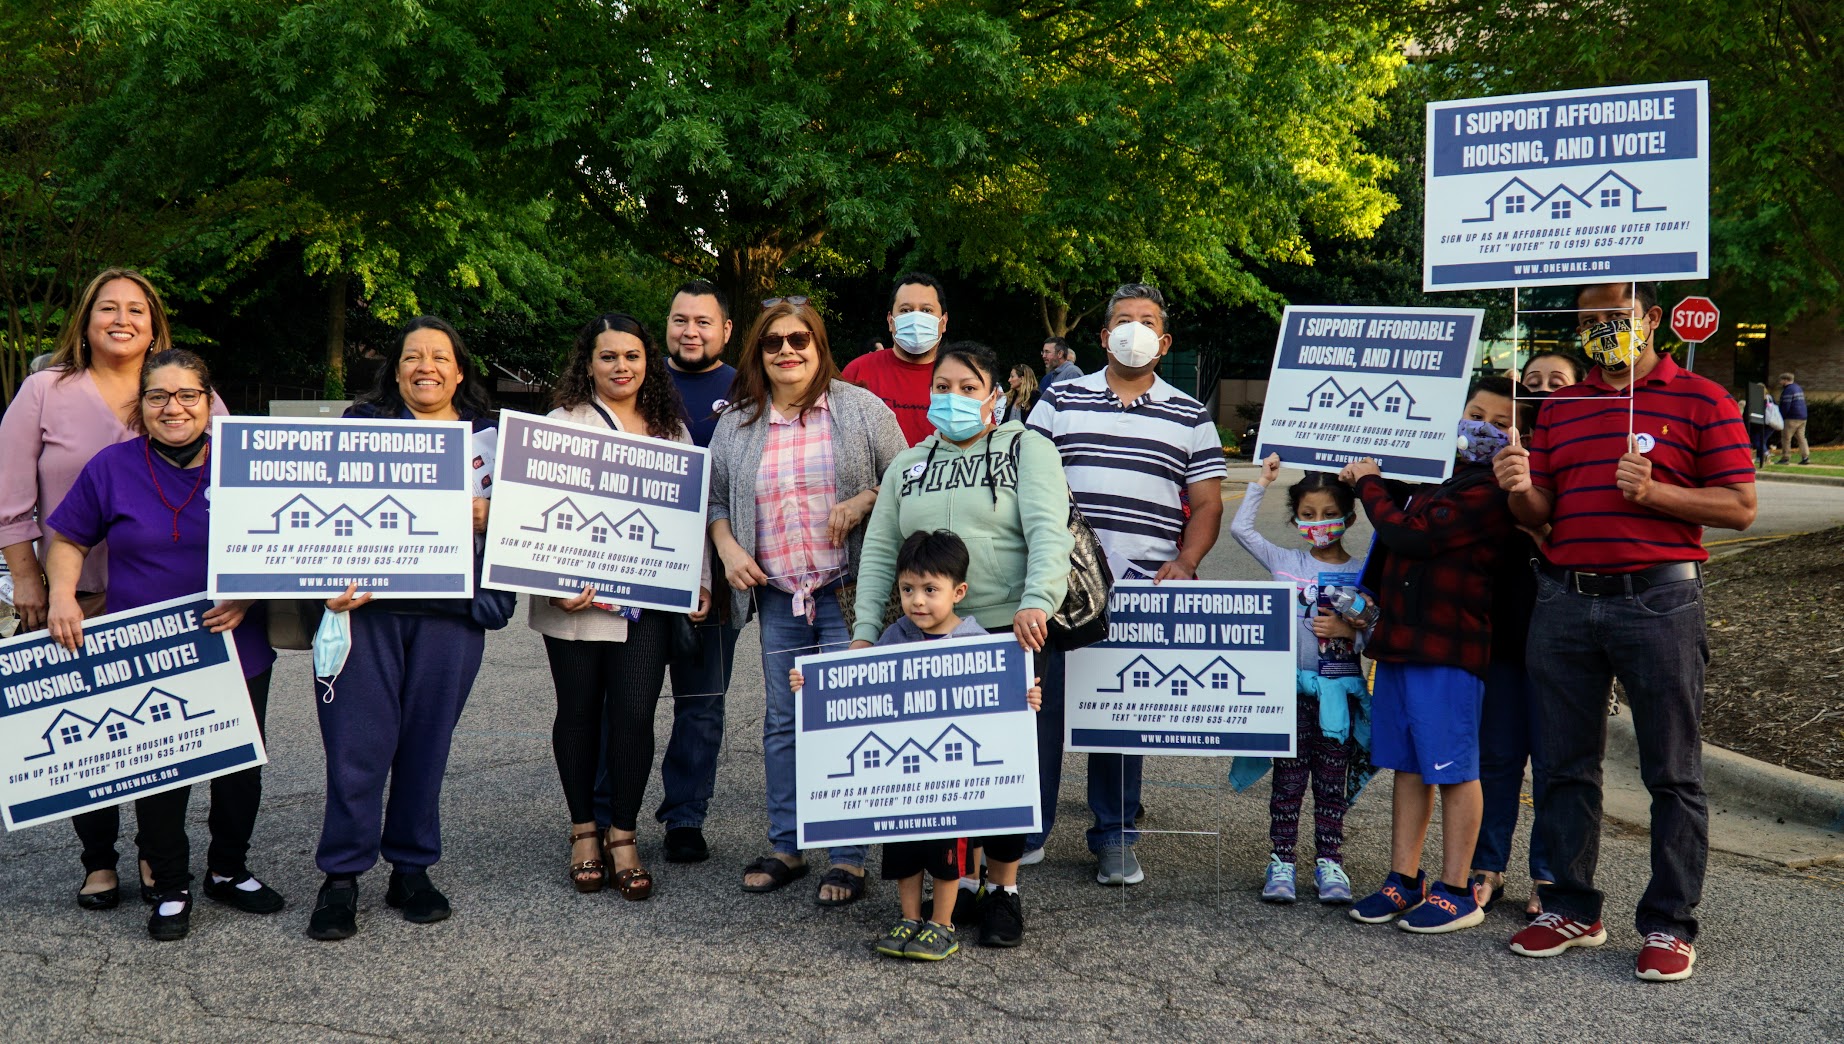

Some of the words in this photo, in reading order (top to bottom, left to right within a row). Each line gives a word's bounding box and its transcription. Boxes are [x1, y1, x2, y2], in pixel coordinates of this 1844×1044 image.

[1455, 115, 1461, 136] I
[1467, 107, 1550, 134] SUPPORT
[1555, 97, 1675, 127] AFFORDABLE
[1463, 140, 1549, 167] HOUSING,
[1555, 137, 1594, 160] AND
[1600, 135, 1606, 157] I
[1612, 131, 1666, 156] VOTE!
[1441, 235, 1462, 244] SIGN
[1466, 233, 1477, 242] UP
[1481, 232, 1492, 241] AS
[1497, 232, 1509, 240] AN
[1513, 228, 1571, 239] AFFORDABLE
[1575, 225, 1616, 235] HOUSING
[1621, 223, 1651, 233] VOTER
[1656, 221, 1690, 231] TODAY!
[1480, 244, 1501, 253] TEXT
[1549, 241, 1560, 249] TO
[1564, 239, 1590, 248] (919)
[1594, 236, 1644, 247] 635-4770
[1515, 261, 1610, 274] WWW.ONEWAKE.ORG
[1298, 318, 1305, 336] I
[1306, 318, 1366, 338] SUPPORT
[1366, 319, 1455, 341] AFFORDABLE
[1674, 310, 1716, 329] STOP
[1298, 346, 1357, 368] HOUSING,
[1361, 348, 1391, 367] AND
[1393, 349, 1400, 368] I
[1403, 349, 1443, 370] VOTE!
[242, 430, 248, 450] I
[253, 430, 333, 451] SUPPORT
[338, 431, 445, 454] AFFORDABLE
[1295, 431, 1311, 439] TEXT
[1342, 435, 1351, 443] TO
[1353, 436, 1372, 445] (919)
[1374, 438, 1410, 448] 635-4770
[1319, 422, 1361, 433] AFFORDABLE
[1362, 426, 1392, 436] HOUSING
[1395, 429, 1417, 438] VOTER
[1419, 431, 1445, 440] TODAY!
[523, 427, 529, 447] I
[532, 429, 599, 459] SUPPORT
[602, 442, 689, 476] AFFORDABLE
[250, 461, 332, 484] HOUSING,
[338, 462, 373, 482] AND
[379, 462, 384, 482] I
[390, 463, 437, 483] VOTE!
[526, 458, 595, 491] HOUSING,
[599, 471, 629, 494] AND
[632, 477, 638, 496] I
[643, 478, 680, 503] VOTE!
[227, 545, 248, 553] SIGN
[252, 545, 263, 553] UP
[267, 545, 278, 553] AS
[298, 545, 353, 553] AFFORDABLE
[357, 545, 394, 553] HOUSING
[399, 545, 425, 553] VOTER
[429, 545, 458, 553] TODAY!
[265, 556, 286, 565] TEXT
[333, 556, 343, 565] TO
[347, 557, 370, 565] (919)
[374, 557, 419, 565] 635-4770
[501, 538, 519, 547] SIGN
[522, 540, 532, 548] UP
[534, 542, 544, 550] AS
[547, 544, 557, 552] AN
[560, 546, 605, 559] AFFORDABLE
[608, 553, 638, 564] HOUSING
[641, 558, 663, 567] VOTER
[665, 561, 689, 571] TODAY!
[532, 553, 550, 562] TEXT
[587, 561, 596, 569] TO
[598, 563, 618, 572] (919)
[621, 566, 657, 577] 635-4770
[1174, 594, 1272, 615] AFFORDABLE
[84, 610, 198, 656] AFFORDABLE
[1105, 622, 1169, 646] OUSING,
[1174, 623, 1206, 643] AND
[1211, 624, 1216, 643] I
[1221, 624, 1264, 644] VOTE!
[3, 671, 91, 710] HOUSING,
[94, 659, 132, 687] AND
[134, 656, 144, 676] I
[145, 642, 199, 673] VOTE!
[818, 670, 823, 691] I
[828, 660, 897, 689] SUPPORT
[903, 648, 1005, 681] AFFORDABLE
[826, 694, 899, 722] HOUSING,
[904, 690, 937, 714] AND
[942, 688, 948, 710] I
[952, 683, 999, 709] VOTE!
[1079, 702, 1097, 710] SIGN
[1139, 703, 1188, 711] AFFORDABLE
[1191, 704, 1225, 712] HOUSING
[1229, 705, 1252, 713] VOTER
[1256, 706, 1284, 714] TODAY!
[1170, 715, 1179, 723] TO
[1182, 715, 1203, 723] (919)
[1207, 716, 1247, 724] 635-4770
[1141, 734, 1220, 744] WWW.ONEWAKE.ORG
[9, 773, 29, 785] SIGN
[33, 769, 44, 778] UP
[48, 765, 58, 775] AS
[63, 761, 74, 771] AN
[78, 746, 132, 767] AFFORDABLE
[137, 735, 174, 752] HOUSING
[178, 728, 204, 741] VOTER
[209, 719, 239, 733] TODAY!
[50, 774, 69, 786] TEXT
[116, 760, 125, 769] TO
[130, 753, 153, 765] (919)
[158, 740, 202, 758] 635-4770
[89, 768, 178, 798] WWW.ONEWAKE.ORG
[810, 790, 828, 800] SIGN
[831, 789, 841, 798] UP
[844, 788, 854, 797] AS
[857, 787, 868, 795] AN
[871, 782, 921, 794] AFFORDABLE
[925, 779, 960, 790] HOUSING
[965, 777, 990, 787] VOTER
[994, 775, 1024, 785] TODAY!
[844, 800, 861, 809] TEXT
[903, 796, 912, 805] TO
[916, 794, 938, 804] (919)
[942, 790, 985, 802] 635-4770
[874, 816, 957, 830] WWW.ONEWAKE.ORG
